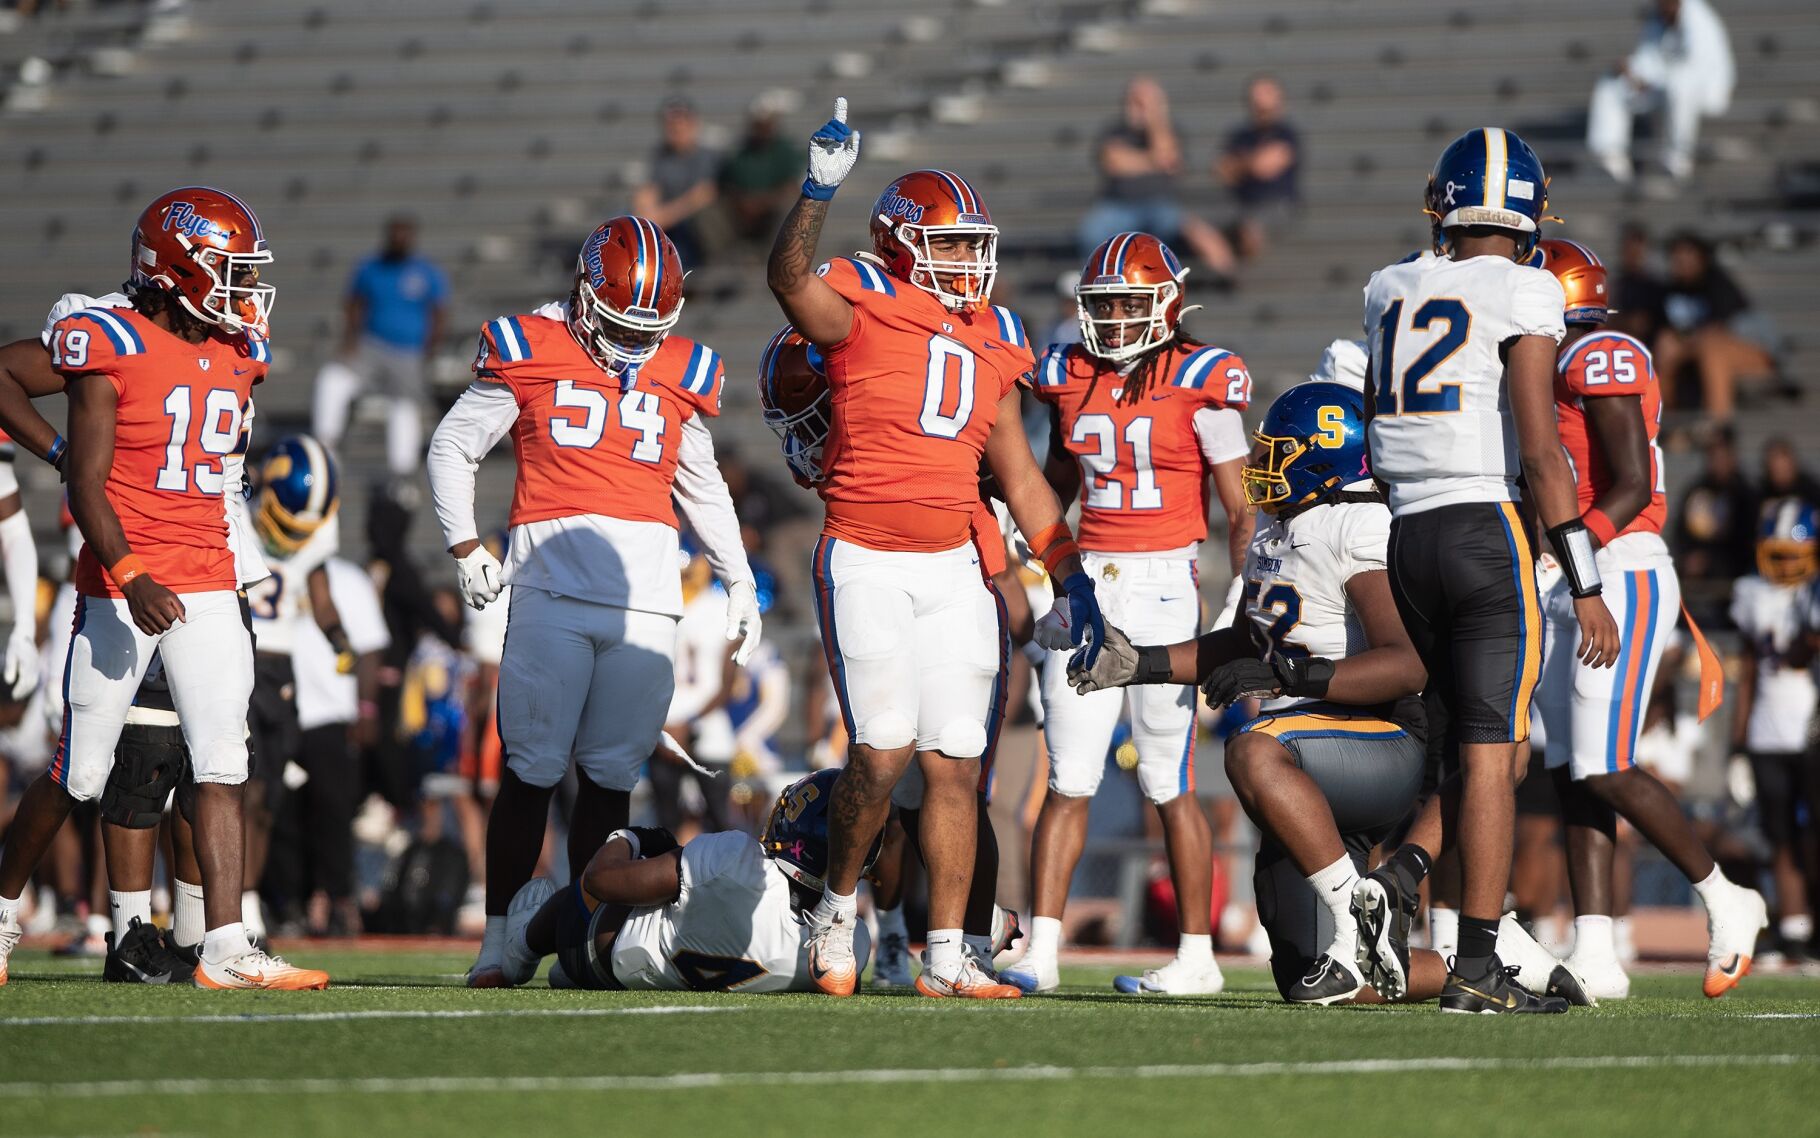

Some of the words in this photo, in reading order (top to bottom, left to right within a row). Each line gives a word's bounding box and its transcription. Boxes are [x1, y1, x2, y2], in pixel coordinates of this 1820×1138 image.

[584, 226, 611, 290] Flyers
[51, 329, 91, 368] 19
[1374, 297, 1472, 416] 12
[1584, 349, 1637, 386] 25
[550, 380, 665, 464] 54
[918, 332, 975, 440] 0
[156, 385, 243, 495] 19
[1071, 414, 1163, 509] 21
[1317, 405, 1346, 449] S
[785, 783, 819, 822] S
